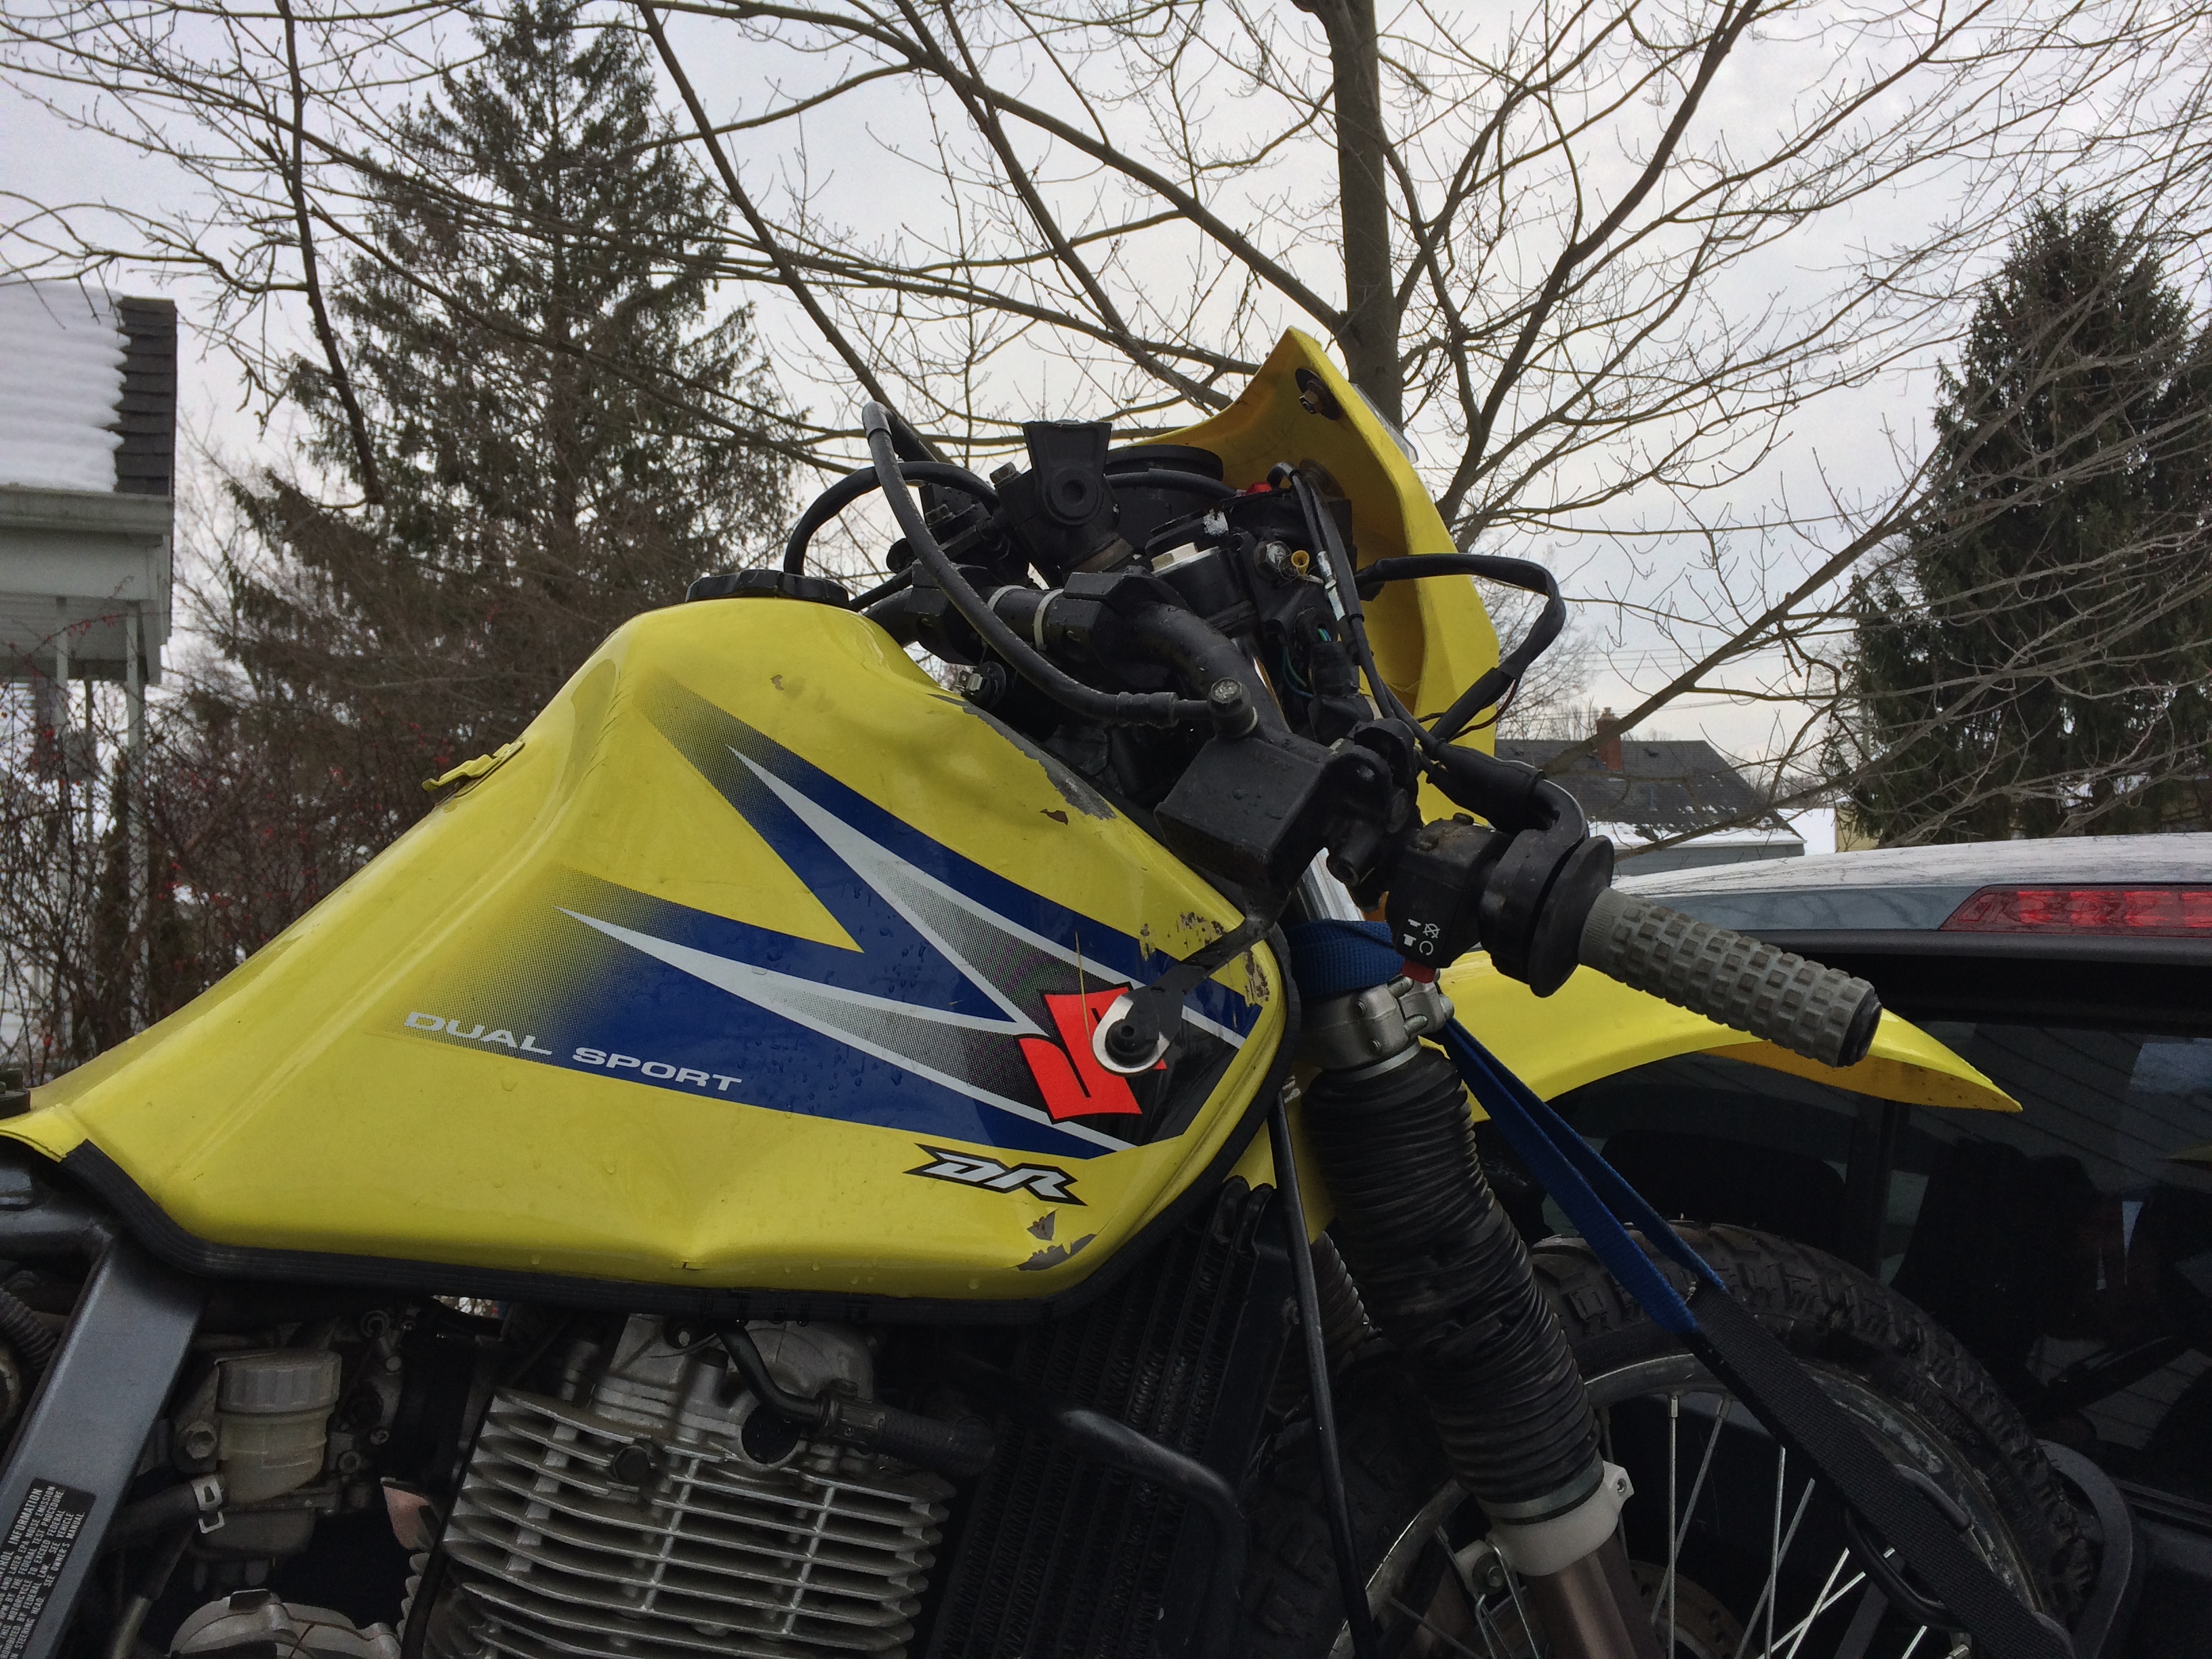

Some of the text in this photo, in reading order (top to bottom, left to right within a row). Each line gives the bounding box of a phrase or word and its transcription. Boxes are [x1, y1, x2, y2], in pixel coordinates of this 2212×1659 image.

[404, 1012, 743, 1091] DUAL SPORT
[904, 1143, 1086, 1205] DR
[0, 1485, 56, 1591] AND LATER EPA NOISE EMISSION
[7, 1487, 43, 1545] INFORMATION
[32, 1528, 46, 1545] TEST
[0, 1625, 21, 1659] ROHIBITED
[16, 1612, 27, 1622] BY
[22, 1582, 43, 1610] FEDERAL
[48, 1540, 61, 1554] SEE
[56, 1511, 75, 1538] VEHICLE
[7, 1578, 33, 1621] MOTORCYCLE
[27, 1566, 39, 1576] TO
[33, 1538, 52, 1564] EXCEED
[46, 1509, 66, 1537] FEDERAL
[10, 1576, 23, 1591] THE
[18, 1547, 38, 1575] FEDERAL
[5, 1593, 16, 1603] BY
[14, 1617, 35, 1650] STEERING
[43, 1574, 56, 1587] SEE
[50, 1542, 70, 1572] OWNER'S
